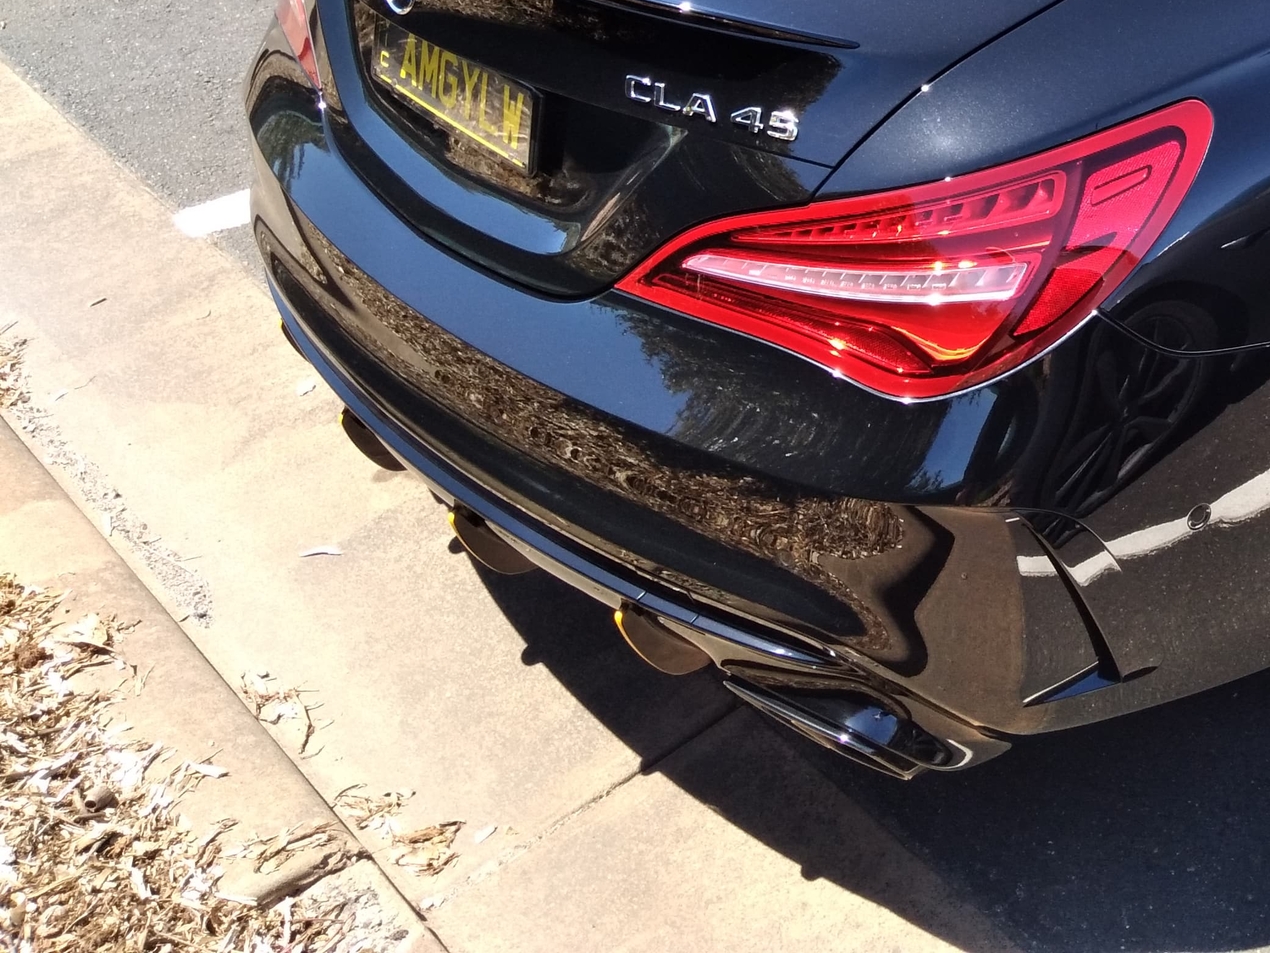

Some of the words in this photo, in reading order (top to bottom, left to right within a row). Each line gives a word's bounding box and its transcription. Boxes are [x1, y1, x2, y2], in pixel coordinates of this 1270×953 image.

[400, 33, 524, 149] AMGYLW
[625, 74, 717, 123] CLA
[730, 106, 799, 141] 45
